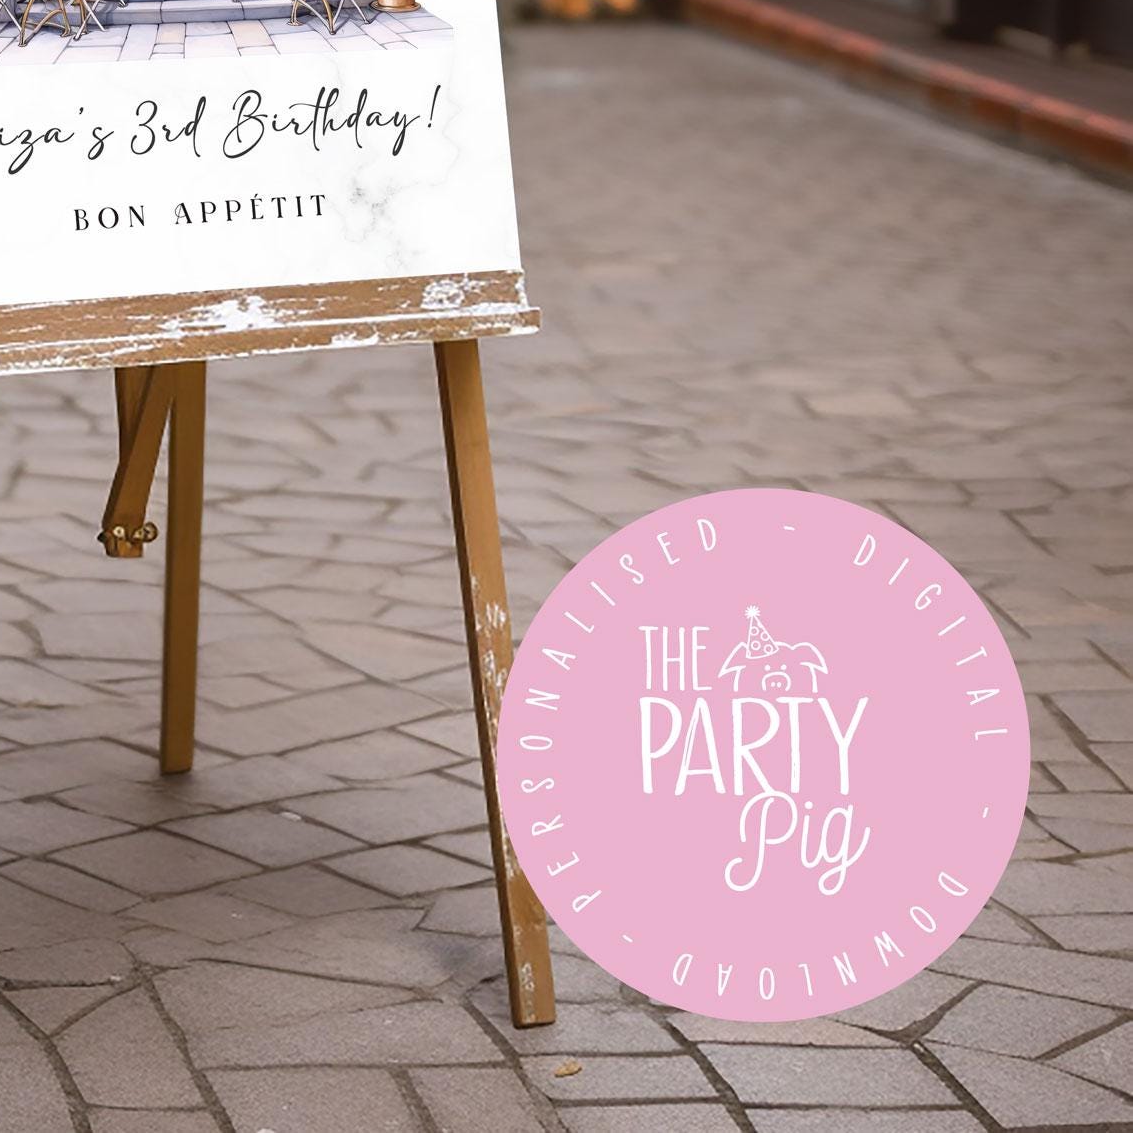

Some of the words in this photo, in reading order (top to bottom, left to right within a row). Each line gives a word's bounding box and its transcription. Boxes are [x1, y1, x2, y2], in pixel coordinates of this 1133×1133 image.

[130, 96, 207, 158] 3rd
[222, 84, 442, 159] Birthday!
[73, 205, 147, 232] BON
[175, 194, 328, 225] APPÉTIT
